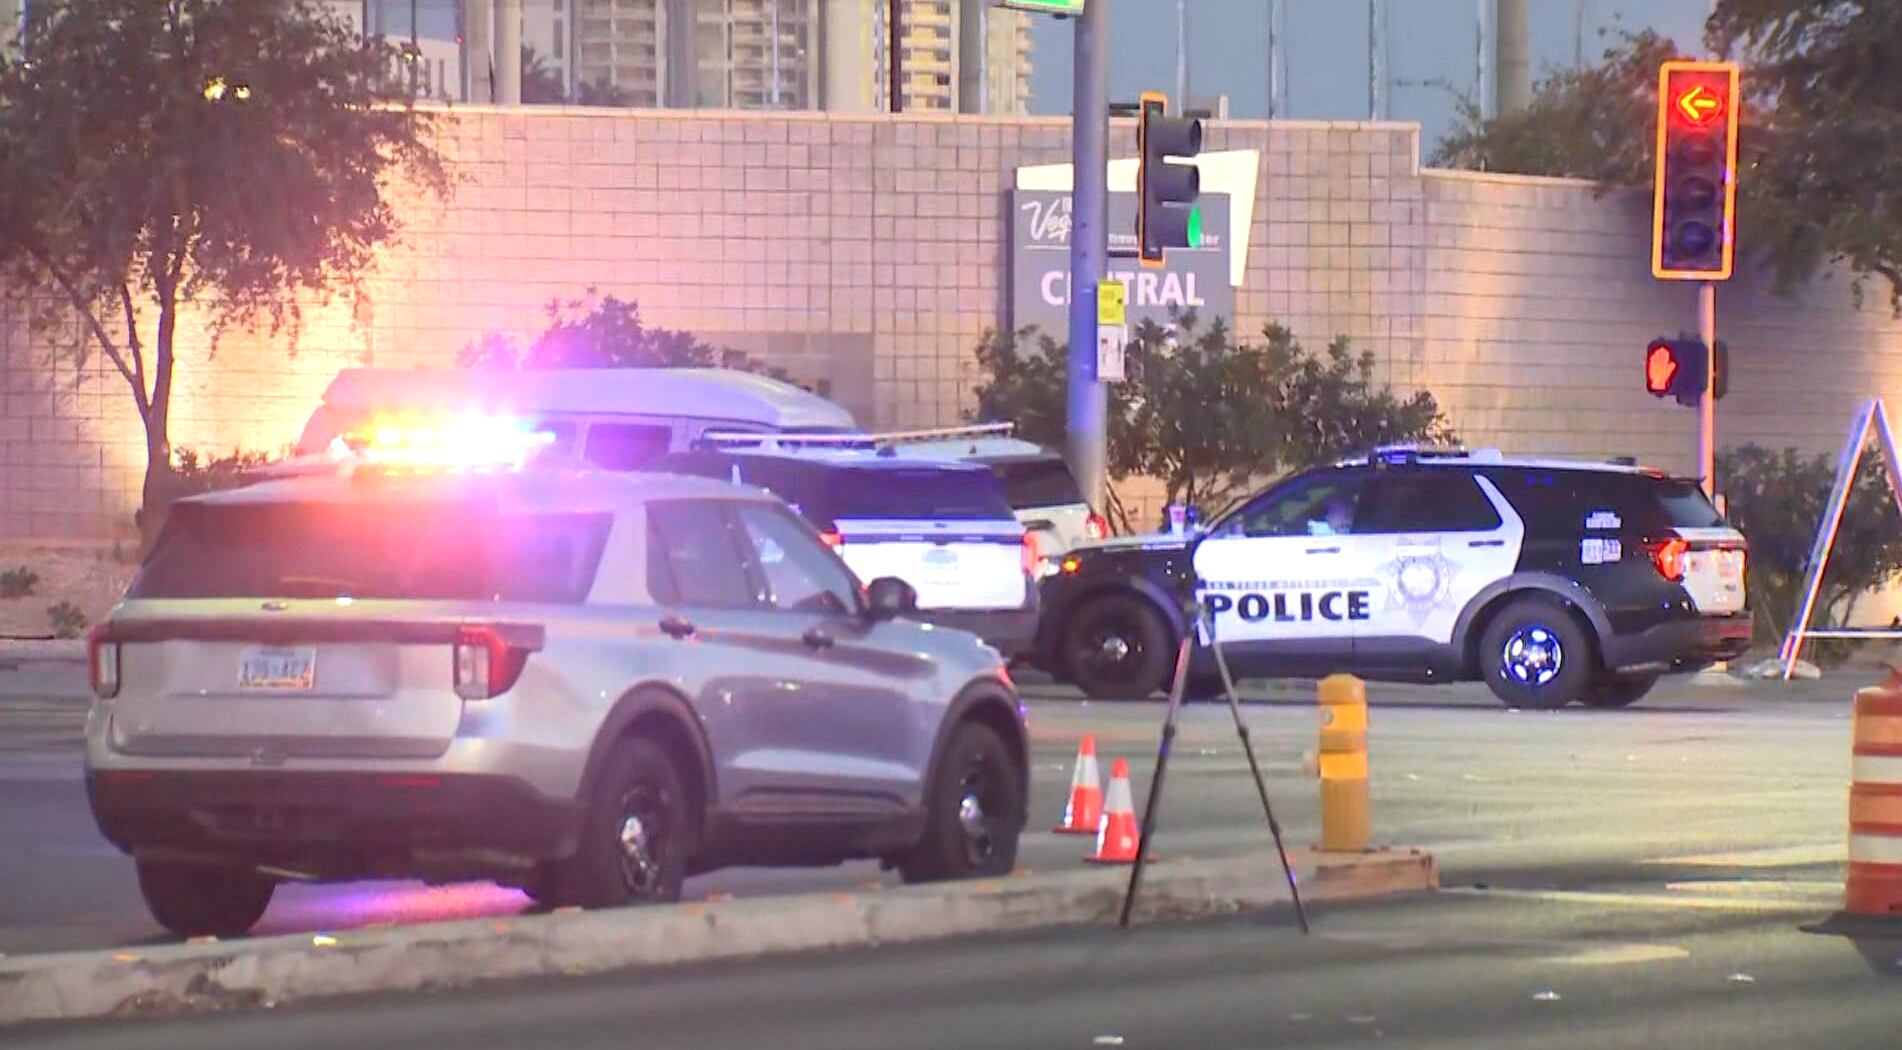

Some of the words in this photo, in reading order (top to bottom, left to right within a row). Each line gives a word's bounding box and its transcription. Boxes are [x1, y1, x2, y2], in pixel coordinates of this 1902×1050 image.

[1021, 197, 1073, 242] Veg
[1041, 270, 1205, 307] CTRAL
[1204, 591, 1370, 623] POLICE
